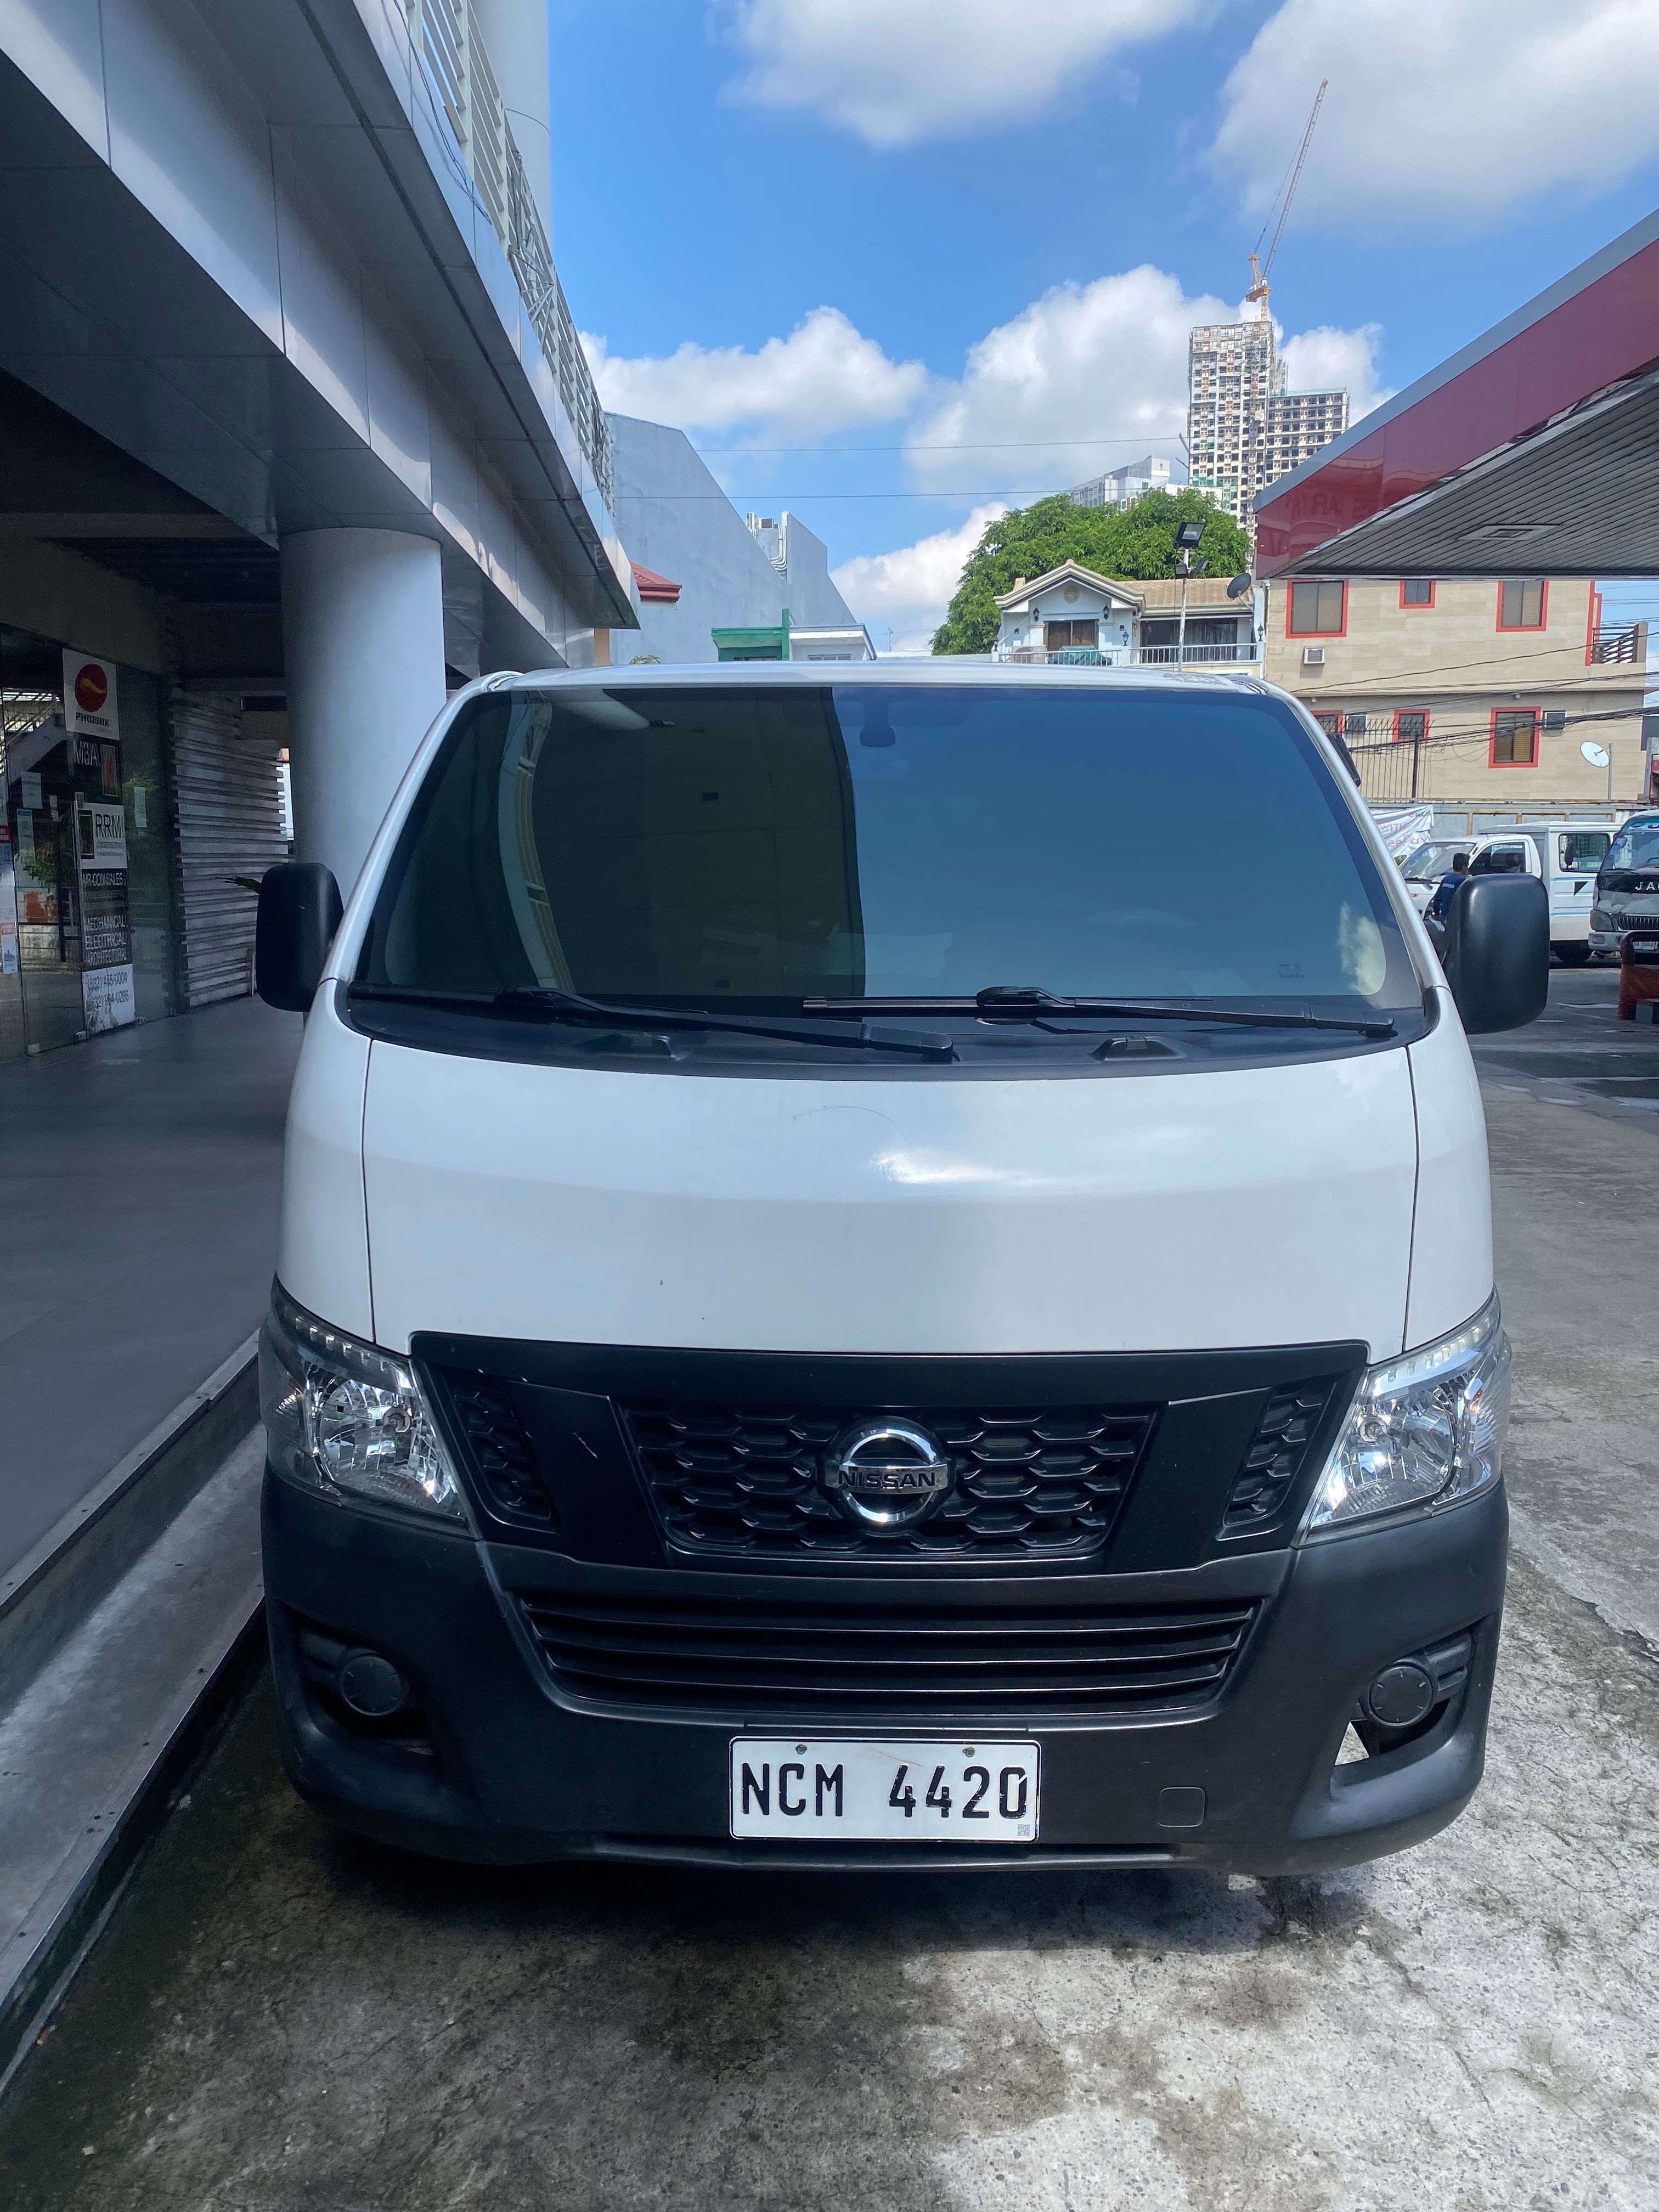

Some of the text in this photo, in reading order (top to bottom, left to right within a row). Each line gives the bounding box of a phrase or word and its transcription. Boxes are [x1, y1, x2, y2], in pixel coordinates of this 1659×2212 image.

[95, 814, 122, 838] RRM
[1387, 834, 1429, 847] eePay
[1635, 882, 1659, 890] JA
[84, 915, 126, 931] MECHANICAL
[85, 932, 126, 950] ELECTRICAL
[838, 1471, 935, 1489] NISSAN
[742, 1762, 1029, 1819] NCM 4420
